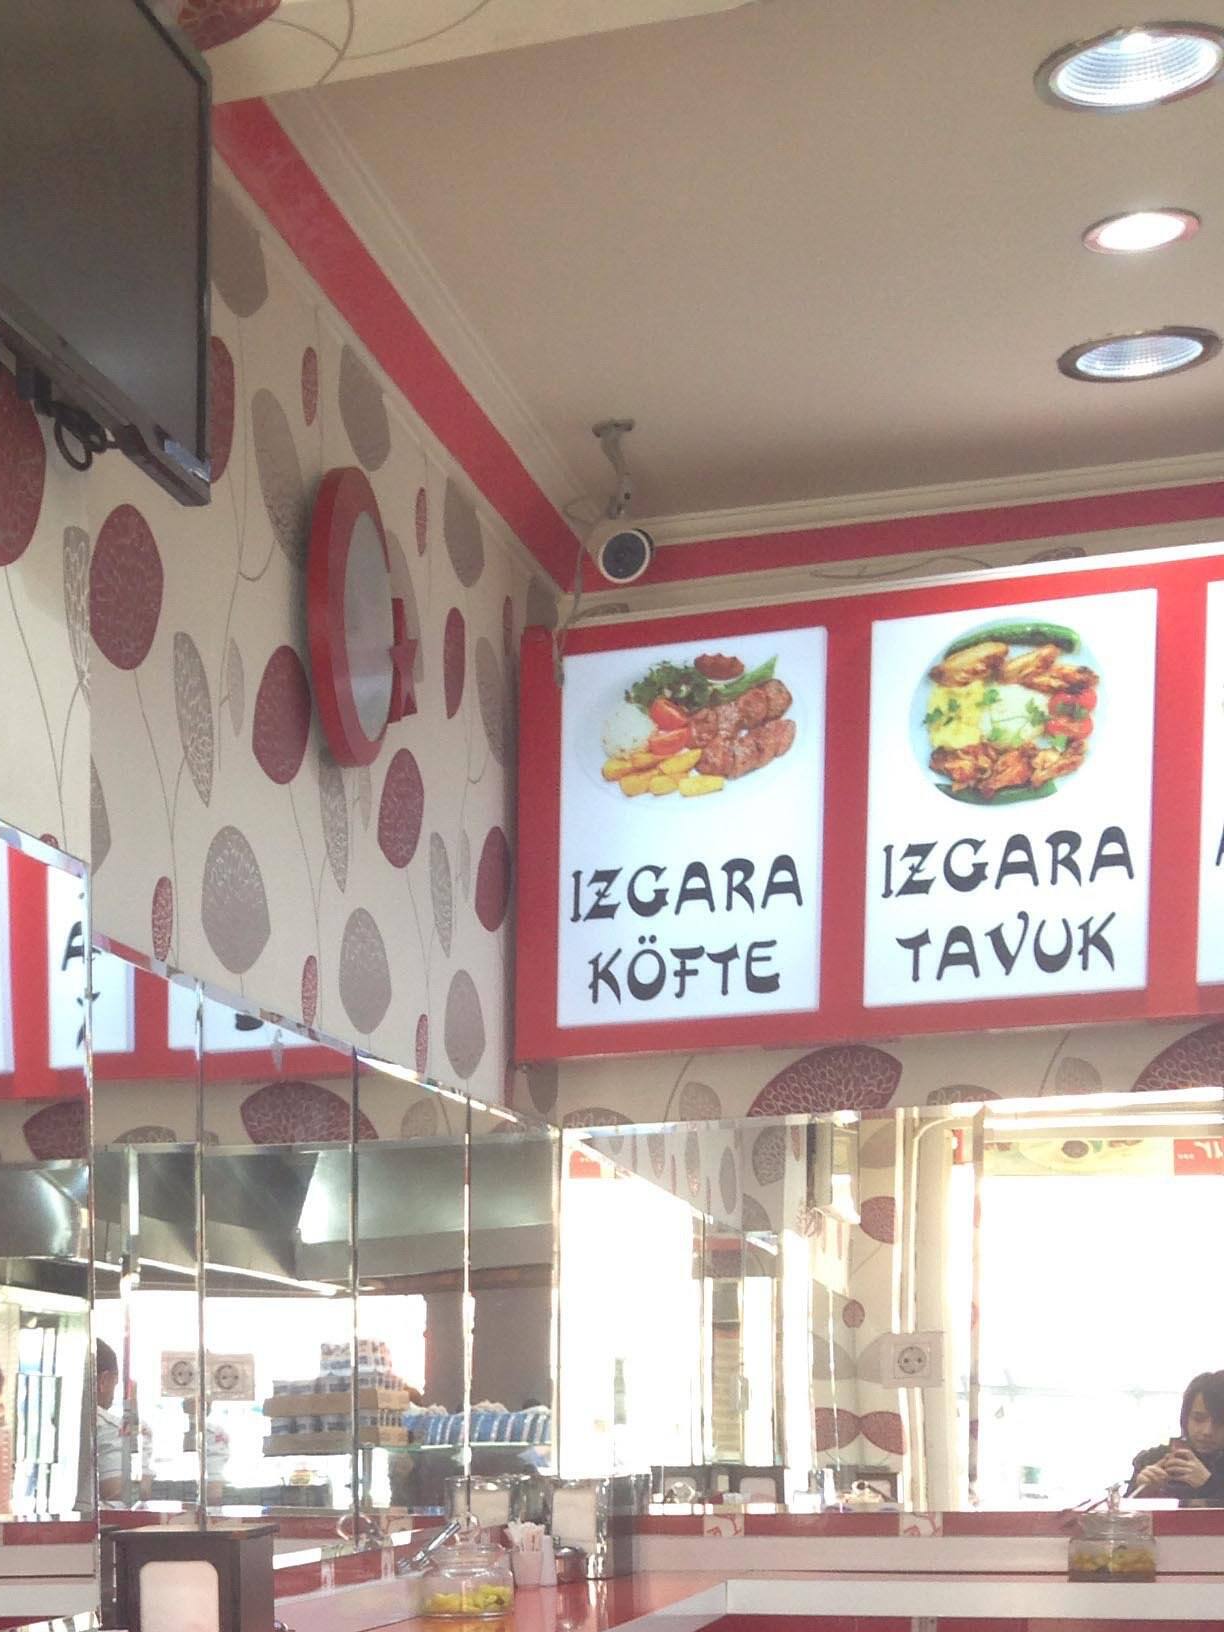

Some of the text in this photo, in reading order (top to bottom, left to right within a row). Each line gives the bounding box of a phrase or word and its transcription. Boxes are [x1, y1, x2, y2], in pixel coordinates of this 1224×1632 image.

[570, 855, 803, 922] IZGARA
[881, 826, 1134, 898] IZGARA
[588, 935, 780, 1004] KÖFTE
[896, 911, 1116, 983] TAVUK
